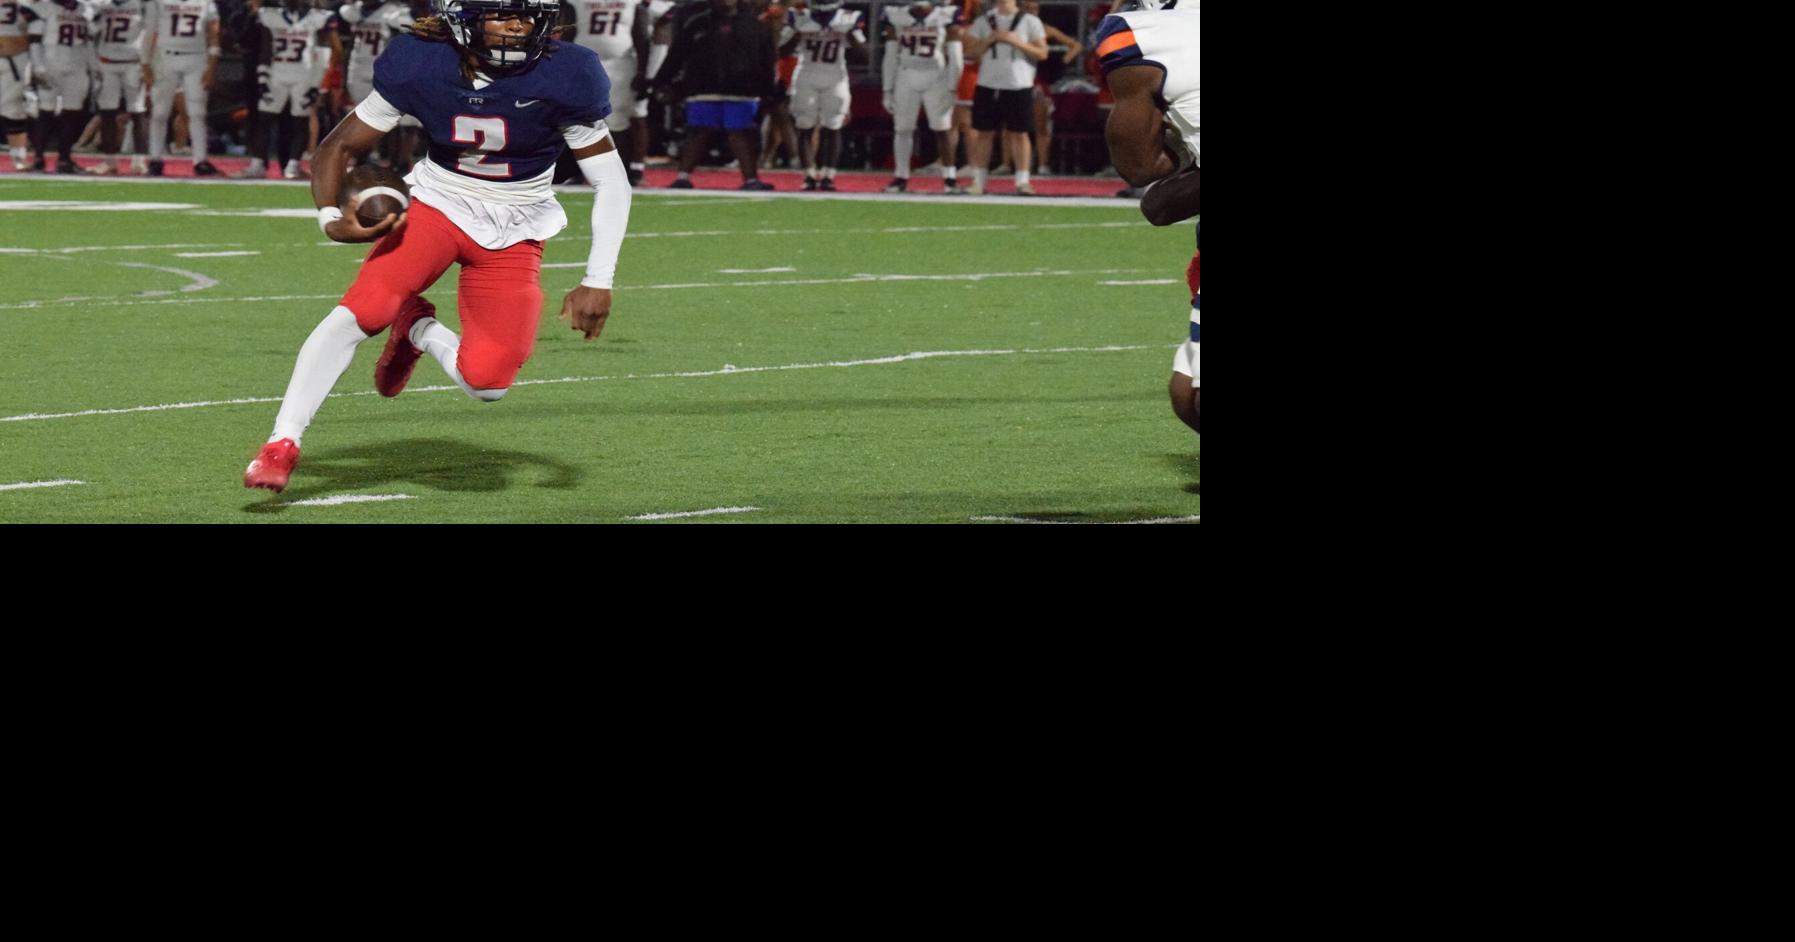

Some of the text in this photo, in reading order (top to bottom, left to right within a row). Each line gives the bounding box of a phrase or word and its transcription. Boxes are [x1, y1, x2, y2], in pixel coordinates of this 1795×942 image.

[105, 17, 131, 42] 12
[170, 14, 199, 37] 13
[589, 11, 621, 36] 61
[274, 38, 307, 62] 23
[806, 39, 841, 63] 40
[901, 34, 937, 58] 45
[452, 114, 512, 178] 2
